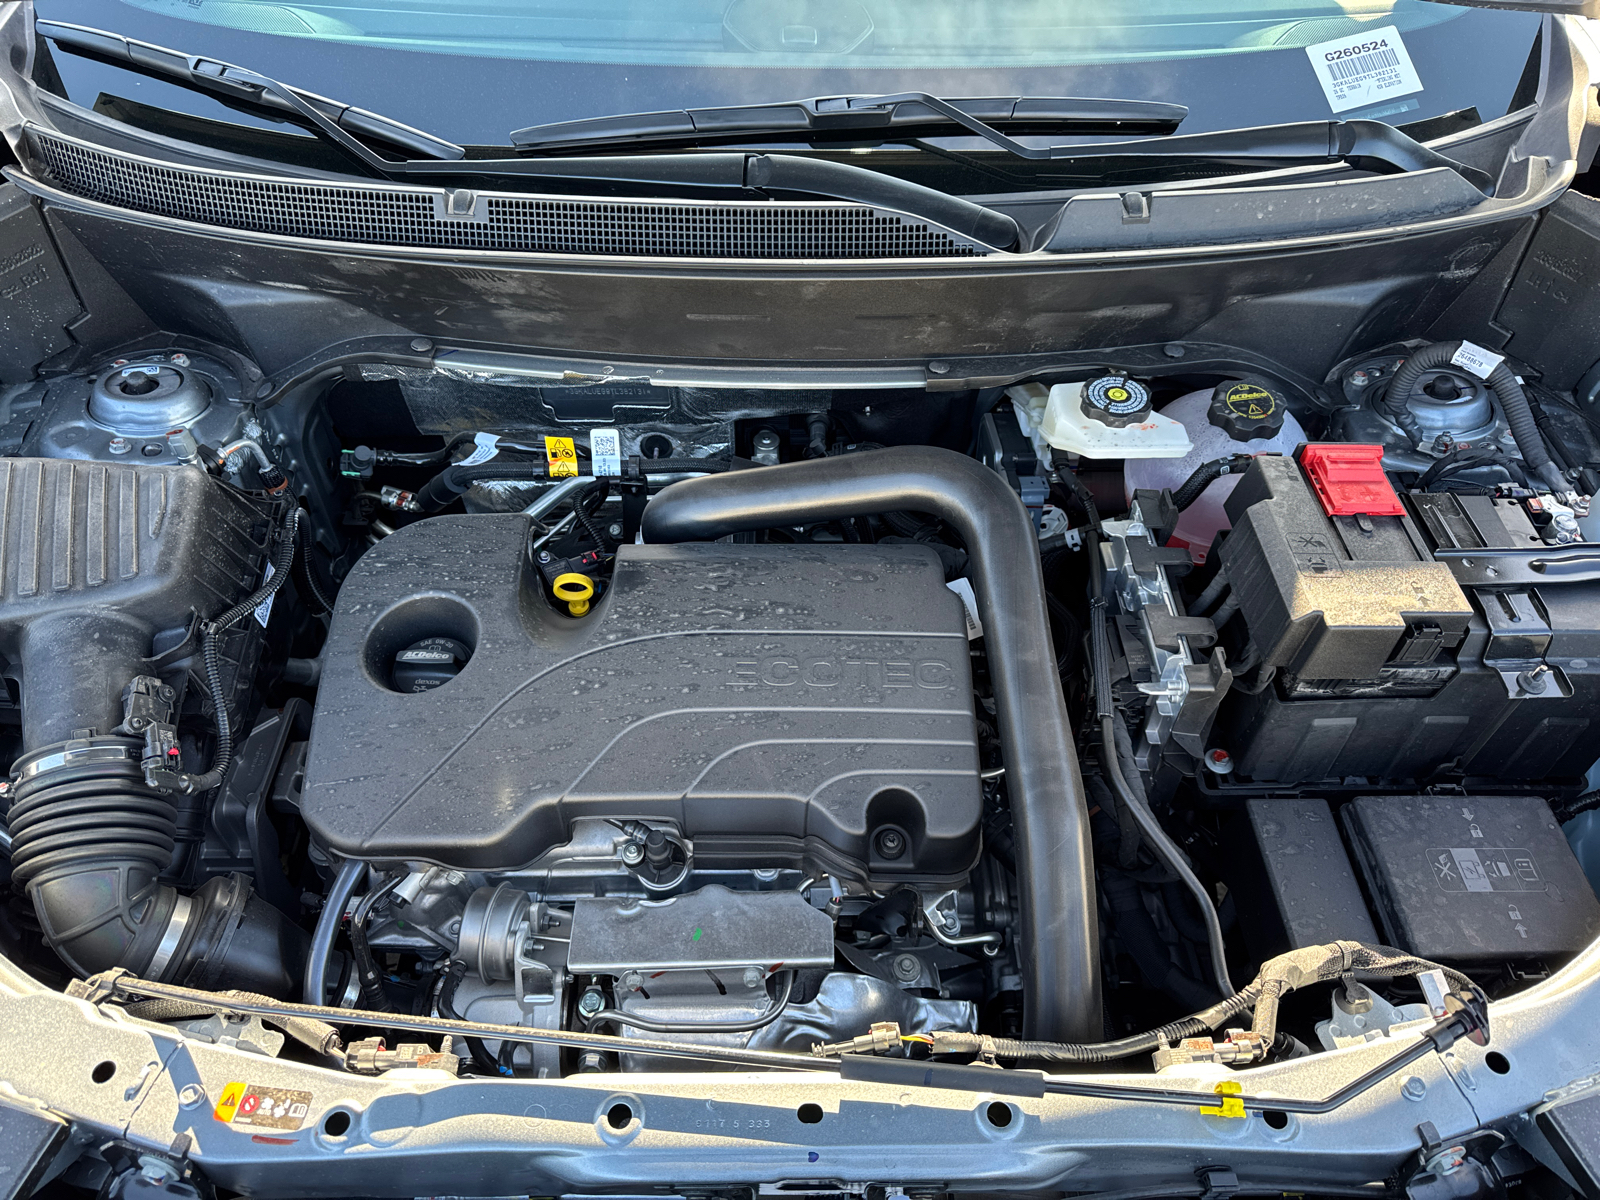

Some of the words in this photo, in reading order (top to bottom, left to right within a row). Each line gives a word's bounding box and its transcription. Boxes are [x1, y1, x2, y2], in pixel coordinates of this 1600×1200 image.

[1325, 39, 1388, 62] G260524
[420, 639, 433, 647] SAE
[402, 651, 449, 659] ACDelco
[726, 656, 952, 690] ECOTEC
